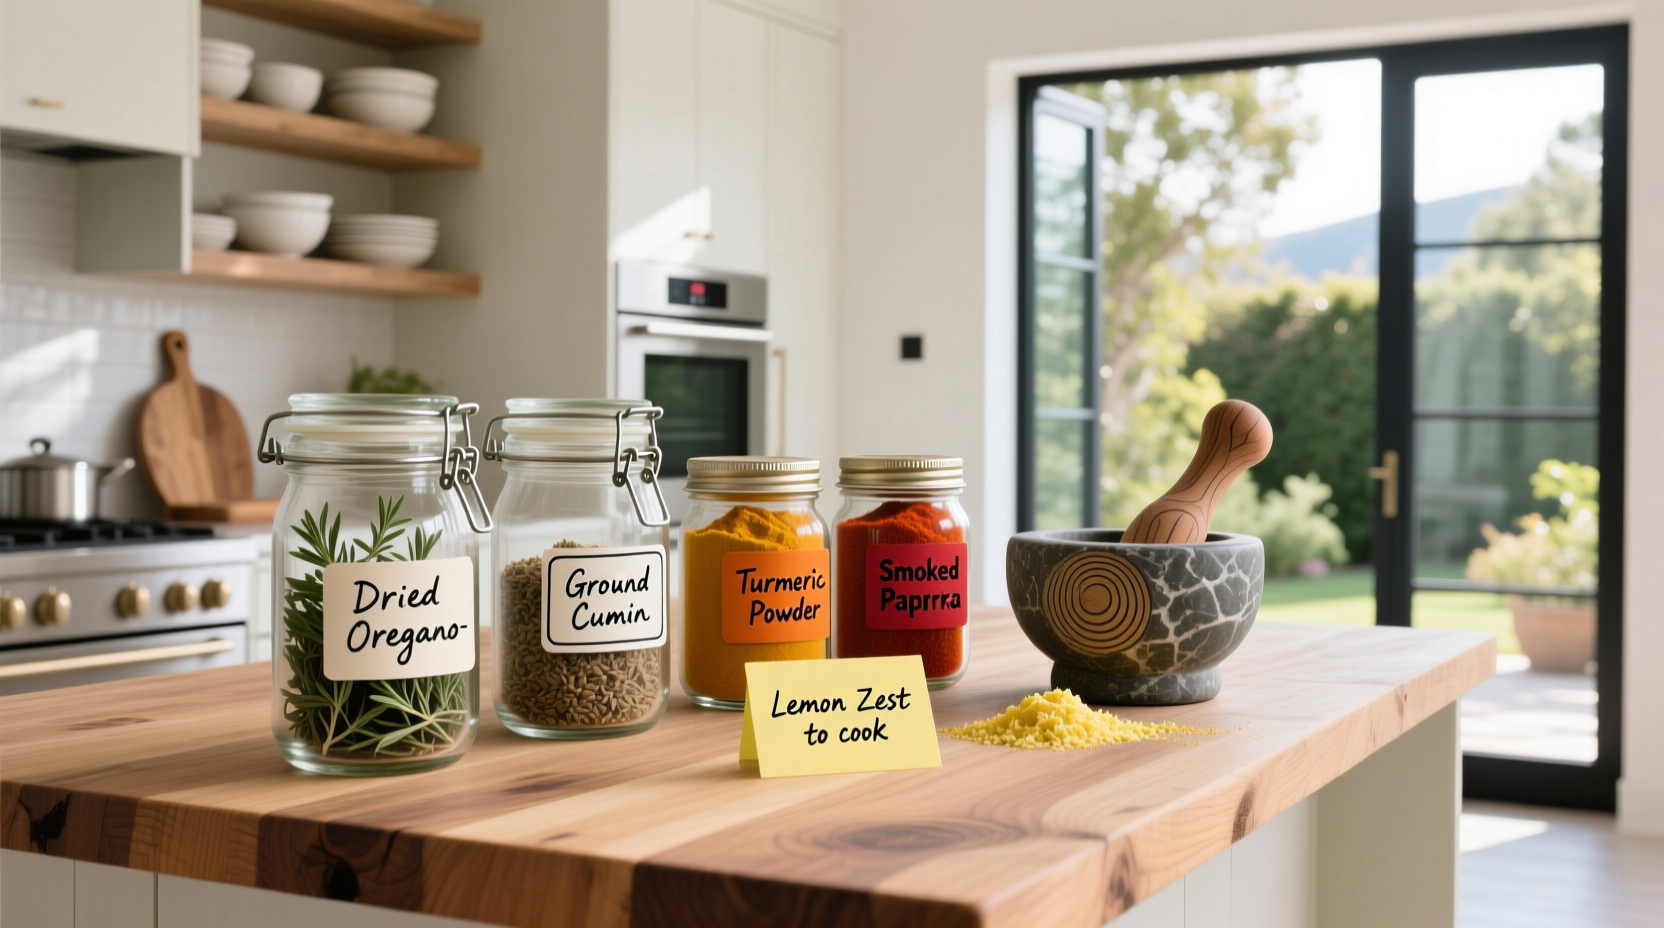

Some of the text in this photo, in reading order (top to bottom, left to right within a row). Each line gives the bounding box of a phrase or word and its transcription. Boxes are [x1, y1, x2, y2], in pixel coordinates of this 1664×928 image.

[565, 564, 650, 599] Ground
[735, 567, 826, 595] Turmeric
[878, 555, 960, 582] Smoked
[352, 575, 440, 614] Dried
[571, 602, 650, 631] Cumin
[749, 596, 821, 626] Powder
[771, 687, 912, 718] Lemon Zest
[803, 717, 889, 746] to cook
